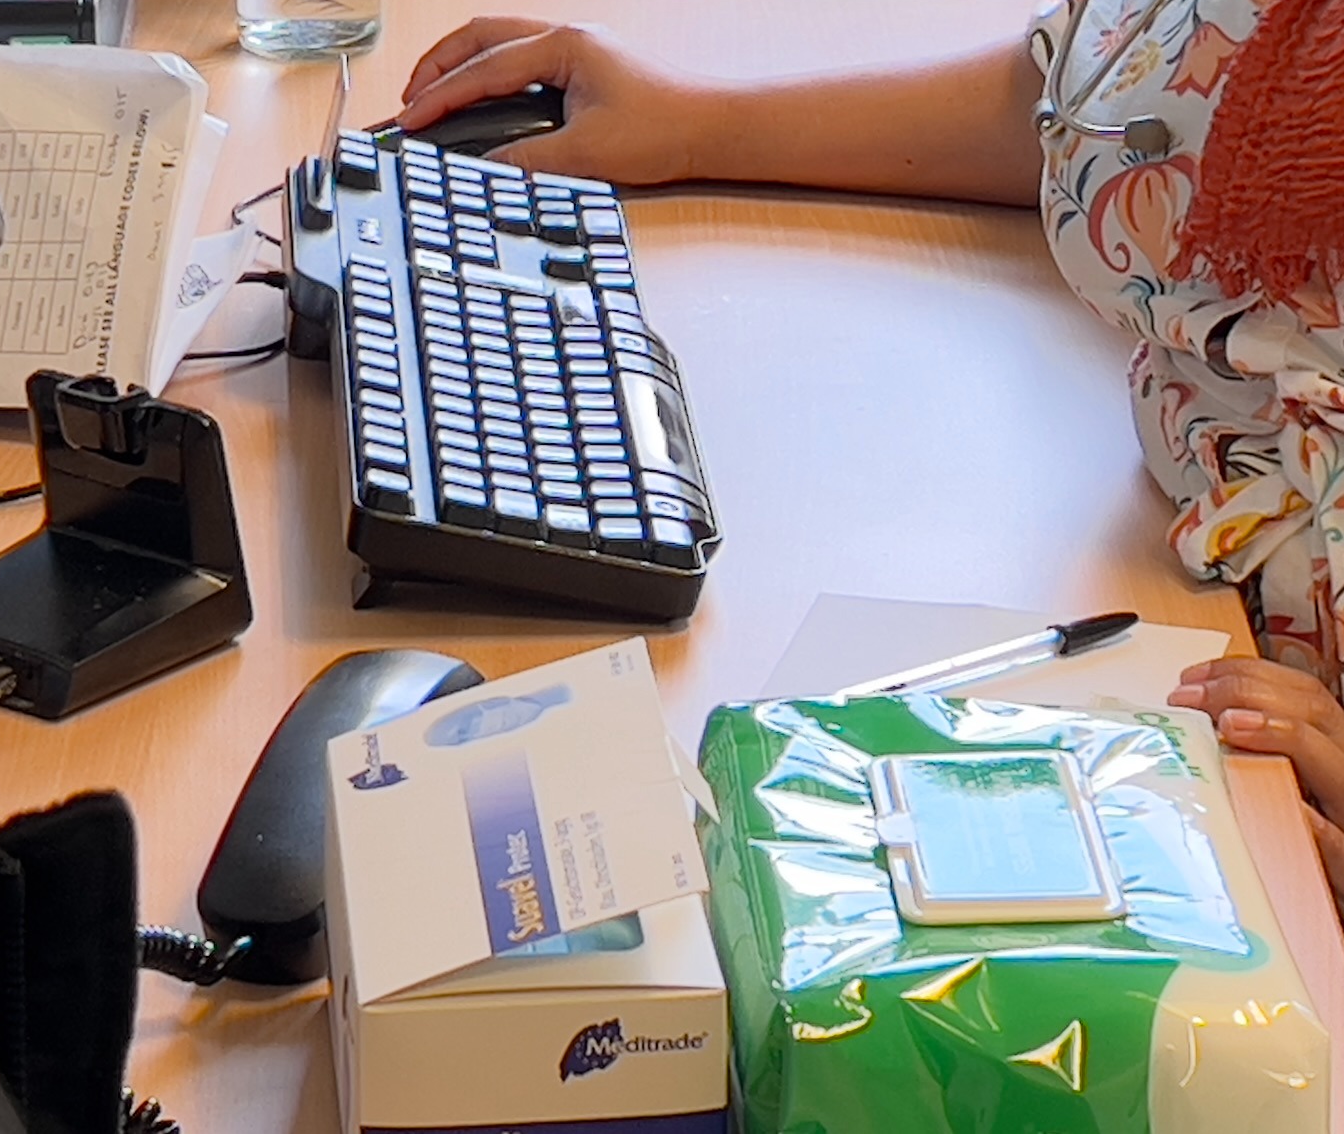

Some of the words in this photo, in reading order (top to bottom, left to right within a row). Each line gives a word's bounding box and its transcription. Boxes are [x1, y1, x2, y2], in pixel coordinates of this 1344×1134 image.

[122, 160, 141, 203] CODES
[107, 205, 131, 280] LANGUAGE
[104, 284, 118, 306] ALL
[102, 310, 114, 332] SEE
[96, 336, 111, 374] LEASE
[496, 873, 544, 942] Suavel
[583, 1032, 705, 1058] Meditrade
